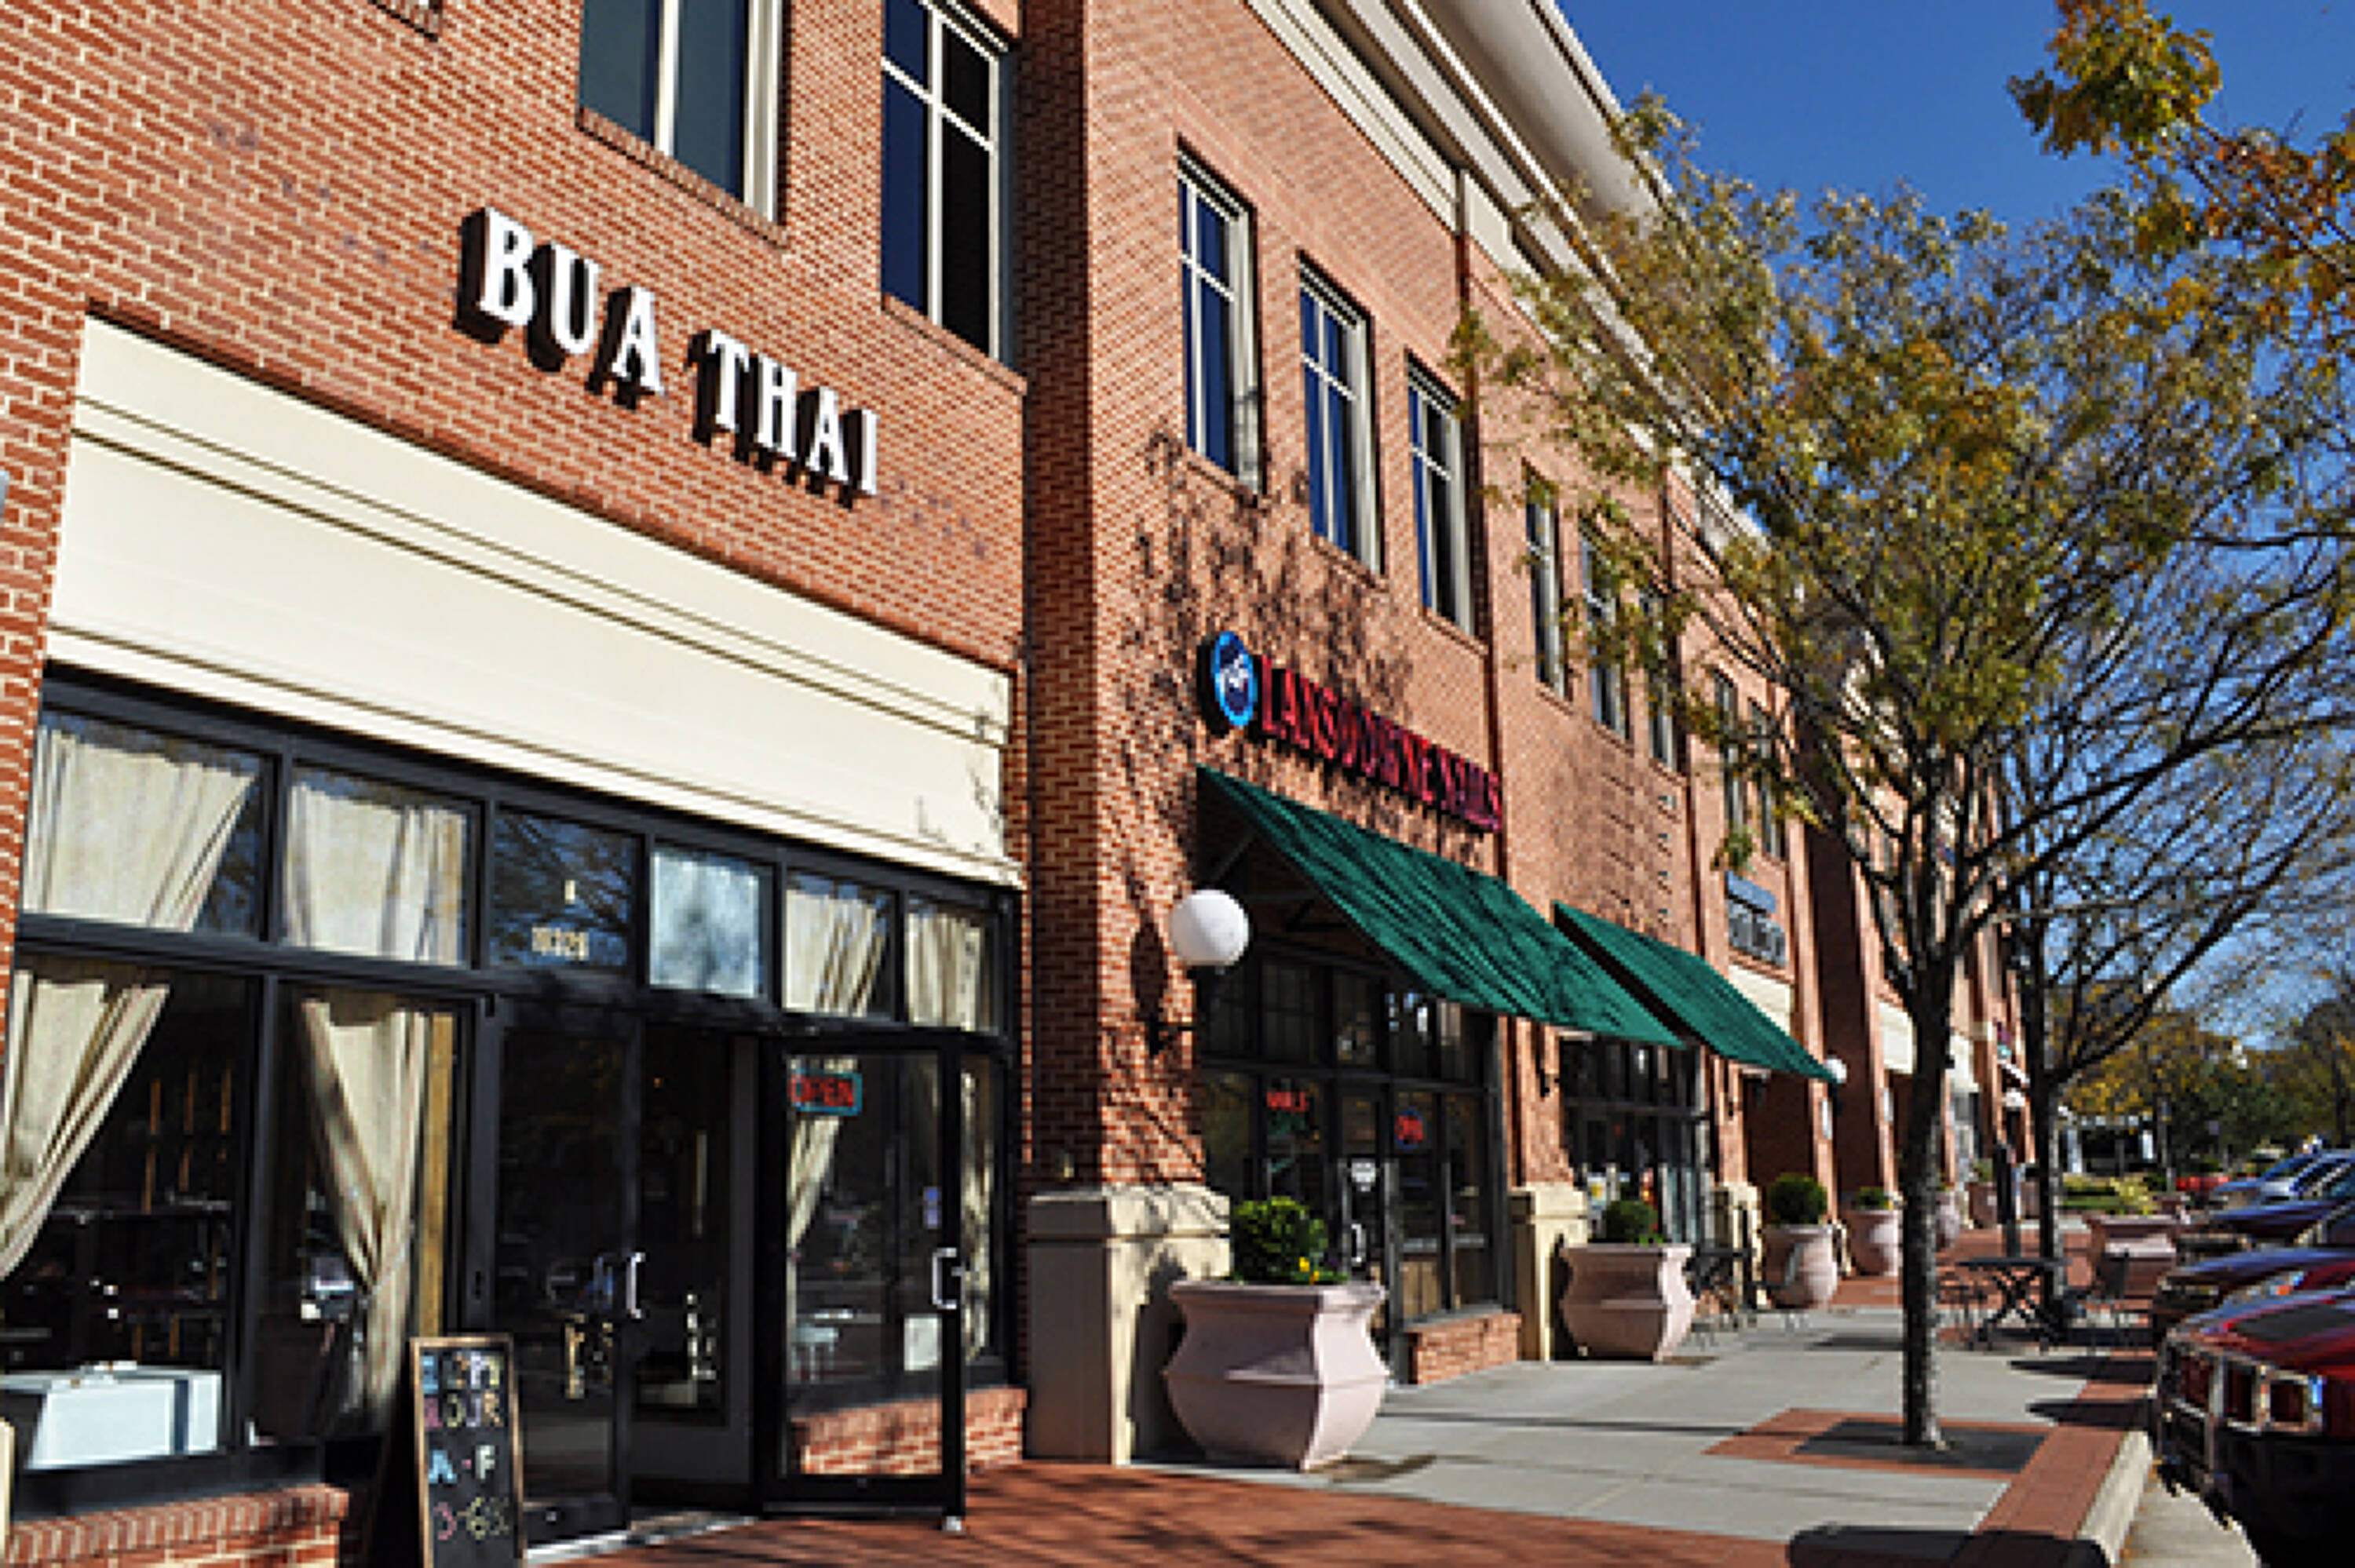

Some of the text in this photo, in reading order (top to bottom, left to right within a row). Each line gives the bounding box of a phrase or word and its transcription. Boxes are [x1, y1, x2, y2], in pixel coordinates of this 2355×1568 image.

[479, 207, 879, 496] BUA THAI
[789, 1074, 853, 1107] OPEN
